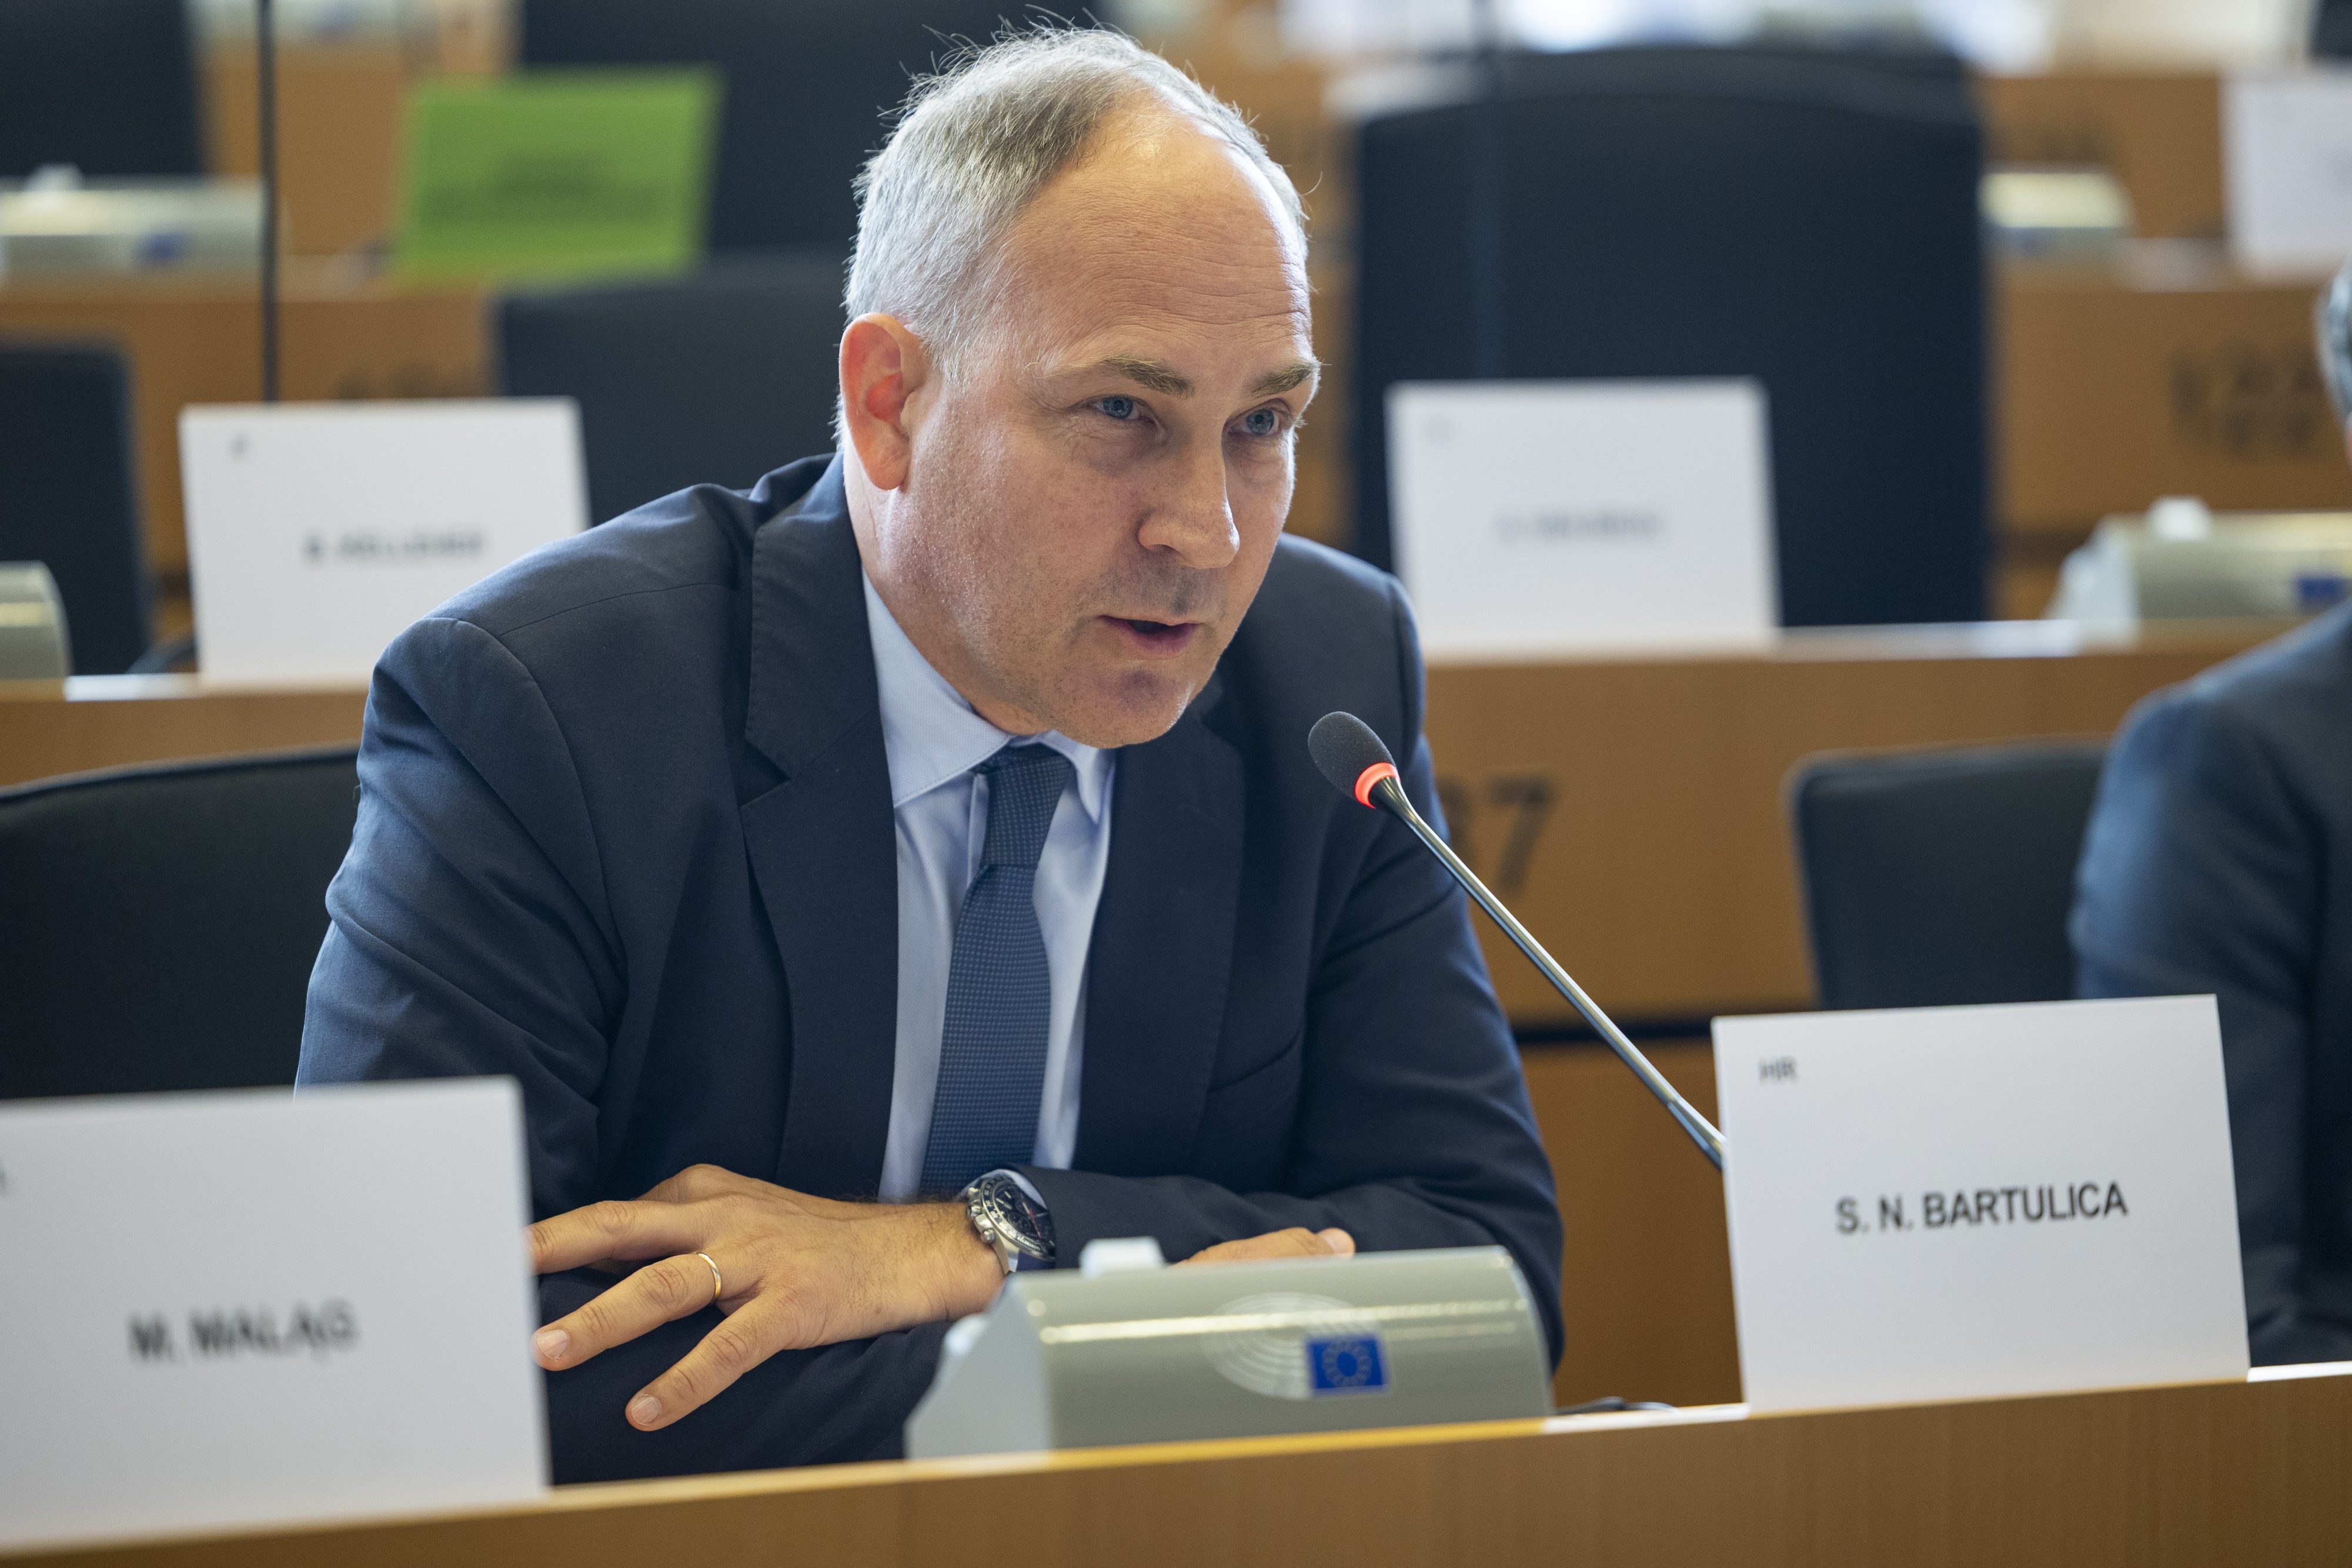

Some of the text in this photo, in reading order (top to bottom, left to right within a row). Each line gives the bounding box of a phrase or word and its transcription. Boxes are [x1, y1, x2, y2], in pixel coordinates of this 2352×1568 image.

[1759, 1057, 1798, 1082] HR
[1836, 1180, 2129, 1235] S. N. BARTULICA
